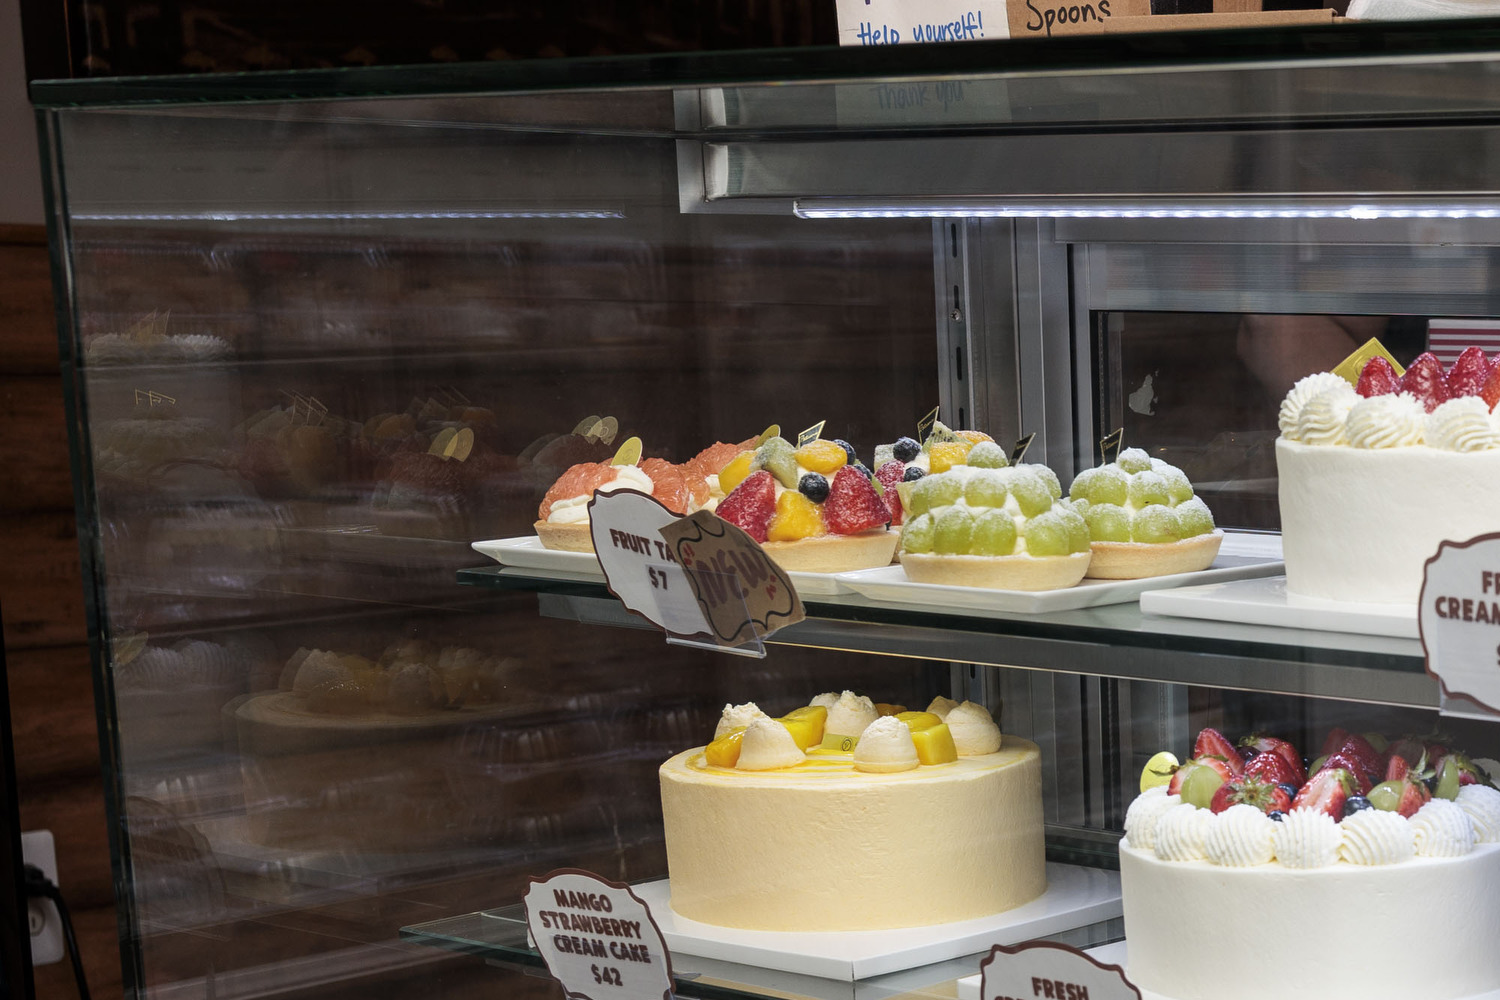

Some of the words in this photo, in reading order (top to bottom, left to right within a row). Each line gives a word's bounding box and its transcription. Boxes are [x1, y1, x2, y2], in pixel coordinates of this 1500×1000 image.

[857, 22, 900, 45] Help
[913, 10, 984, 43] yourself!
[1026, 0, 1111, 37] Spoons
[870, 82, 928, 110] Thank
[609, 528, 652, 557] FRUIT
[654, 540, 677, 563] TA
[648, 567, 668, 590] $7
[696, 544, 769, 609] NEW
[553, 889, 613, 913] MANGO
[539, 910, 642, 939] STRAWBERRY
[553, 934, 608, 959] CREAM
[609, 941, 651, 964] CAKE
[590, 963, 623, 987] $42
